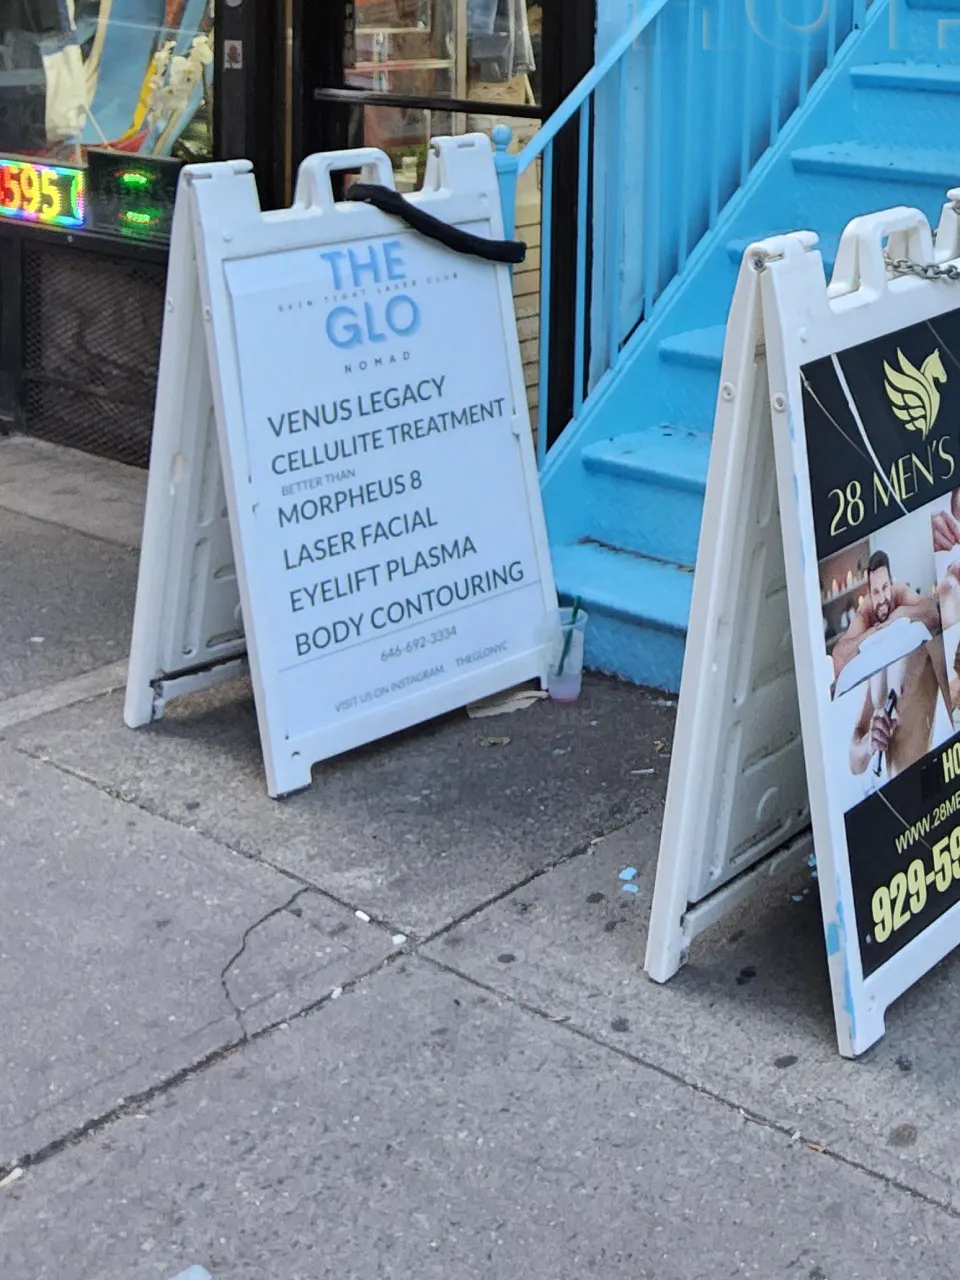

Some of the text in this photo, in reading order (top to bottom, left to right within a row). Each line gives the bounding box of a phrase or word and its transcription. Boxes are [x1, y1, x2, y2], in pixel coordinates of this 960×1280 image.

[319, 240, 407, 291] THE
[325, 294, 422, 350] GLO
[344, 351, 411, 373] NOMAD
[267, 375, 446, 438] VENUS LEGACY
[271, 397, 505, 475] CELLULITE TREATMENT
[277, 470, 423, 528] MORPHEUS 8
[281, 468, 356, 497] BETTER THAN
[827, 480, 865, 537] 28
[873, 435, 955, 515] MEN'S
[283, 507, 439, 571] LASER FACIAL
[289, 535, 478, 613] EYELIFT PLASMA
[295, 560, 524, 657] BODY CONTOURING
[380, 625, 458, 662] 646-692-3334
[334, 695, 358, 712] VISIT
[360, 691, 374, 704] US
[373, 685, 390, 698] ON
